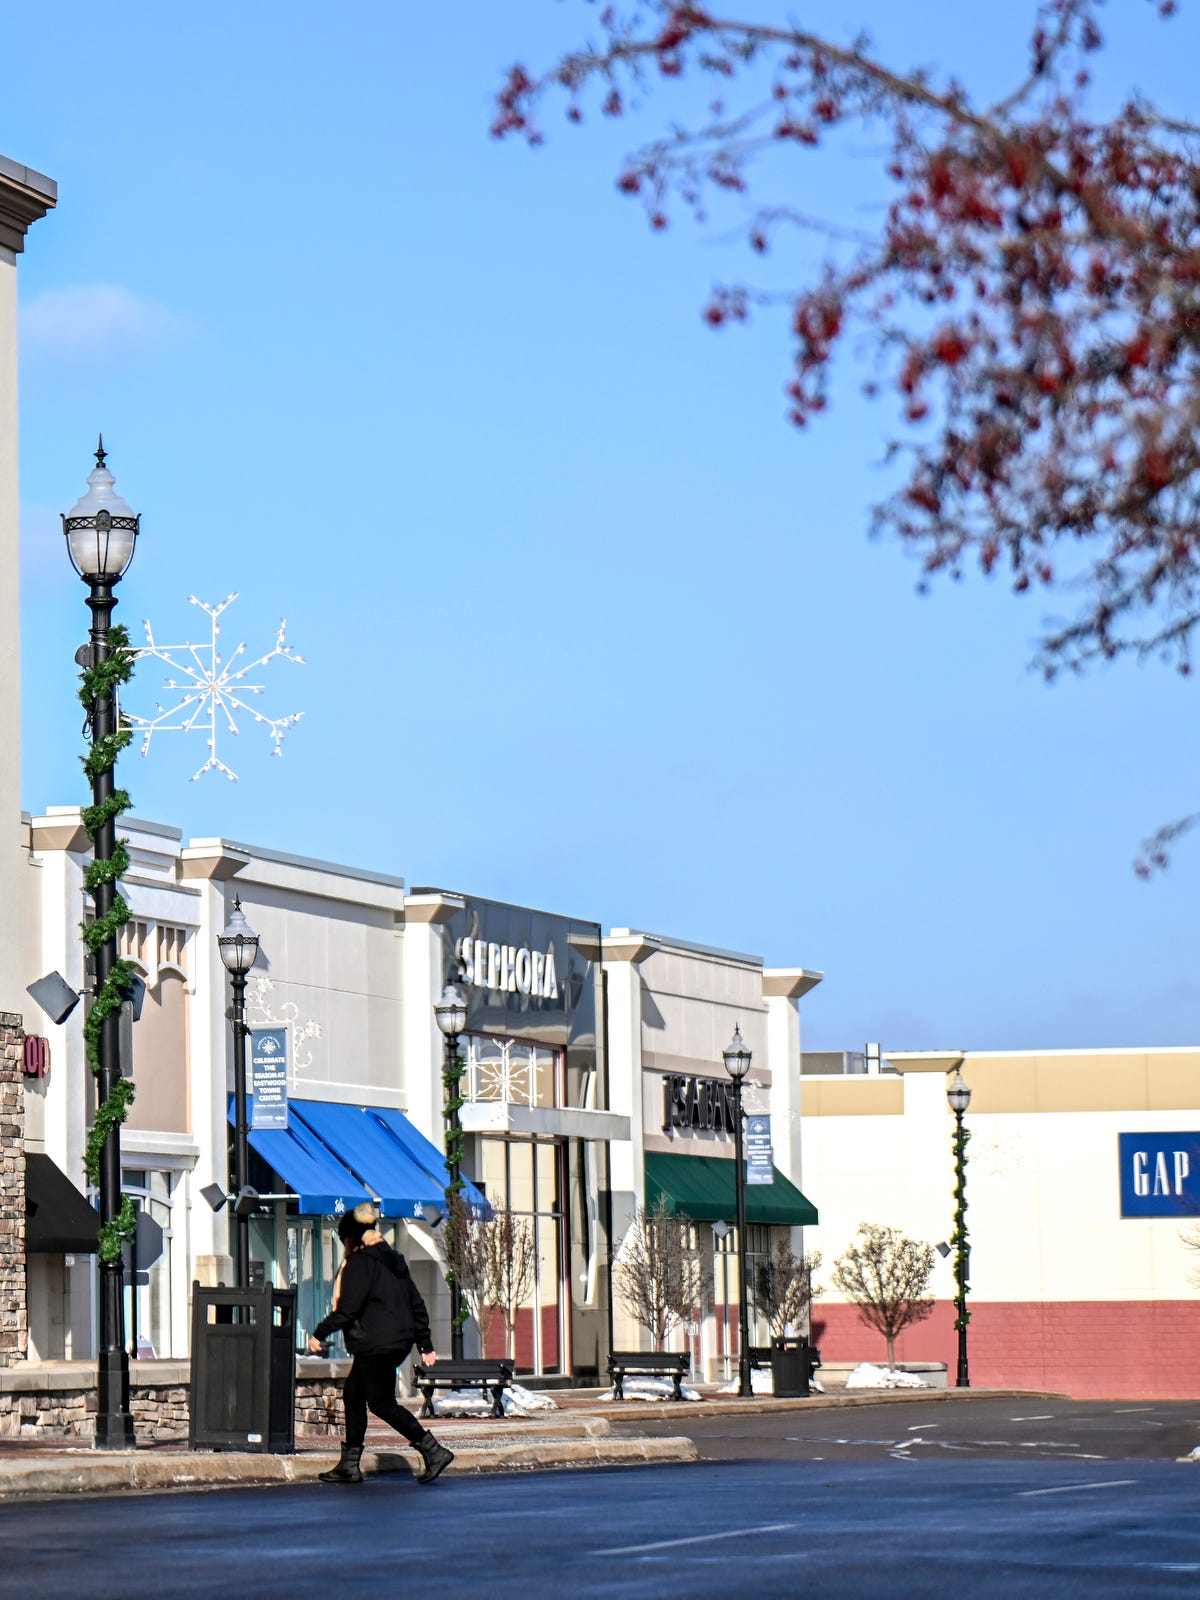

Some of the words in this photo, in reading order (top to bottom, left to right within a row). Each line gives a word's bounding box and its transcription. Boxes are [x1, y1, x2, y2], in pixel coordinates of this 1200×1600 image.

[458, 937, 558, 999] SEPHORA
[22, 1034, 50, 1078] op
[253, 1056, 286, 1064] CELEBRATE
[698, 1080, 736, 1133] BAN
[1133, 1151, 1190, 1196] GAP
